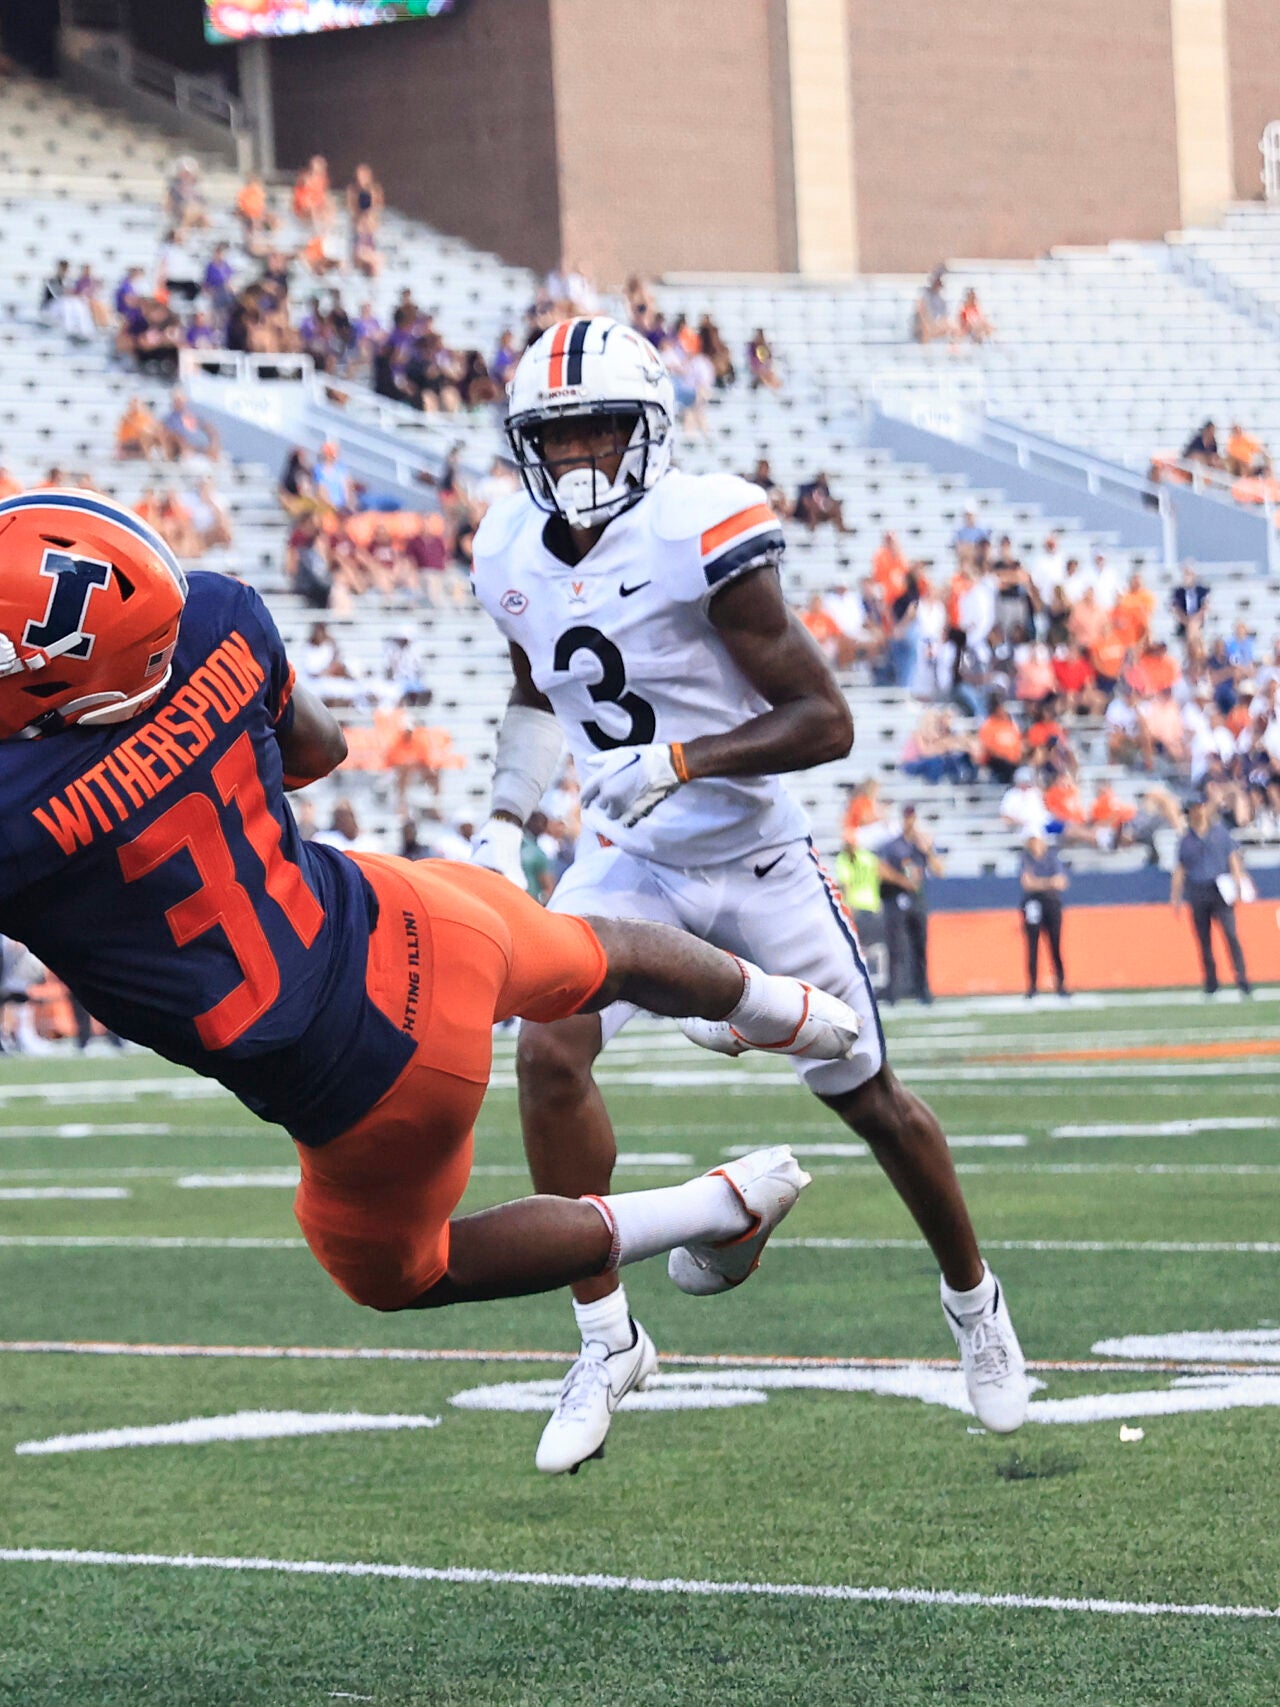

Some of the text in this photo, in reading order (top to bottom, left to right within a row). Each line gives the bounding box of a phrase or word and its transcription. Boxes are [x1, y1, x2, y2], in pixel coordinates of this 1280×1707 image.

[21, 549, 113, 661] I
[571, 581, 584, 597] V
[32, 630, 266, 856] WITHERSPOON
[553, 625, 656, 751] 3
[117, 730, 325, 1051] 31
[402, 910, 420, 1033] HTING ILLINI
